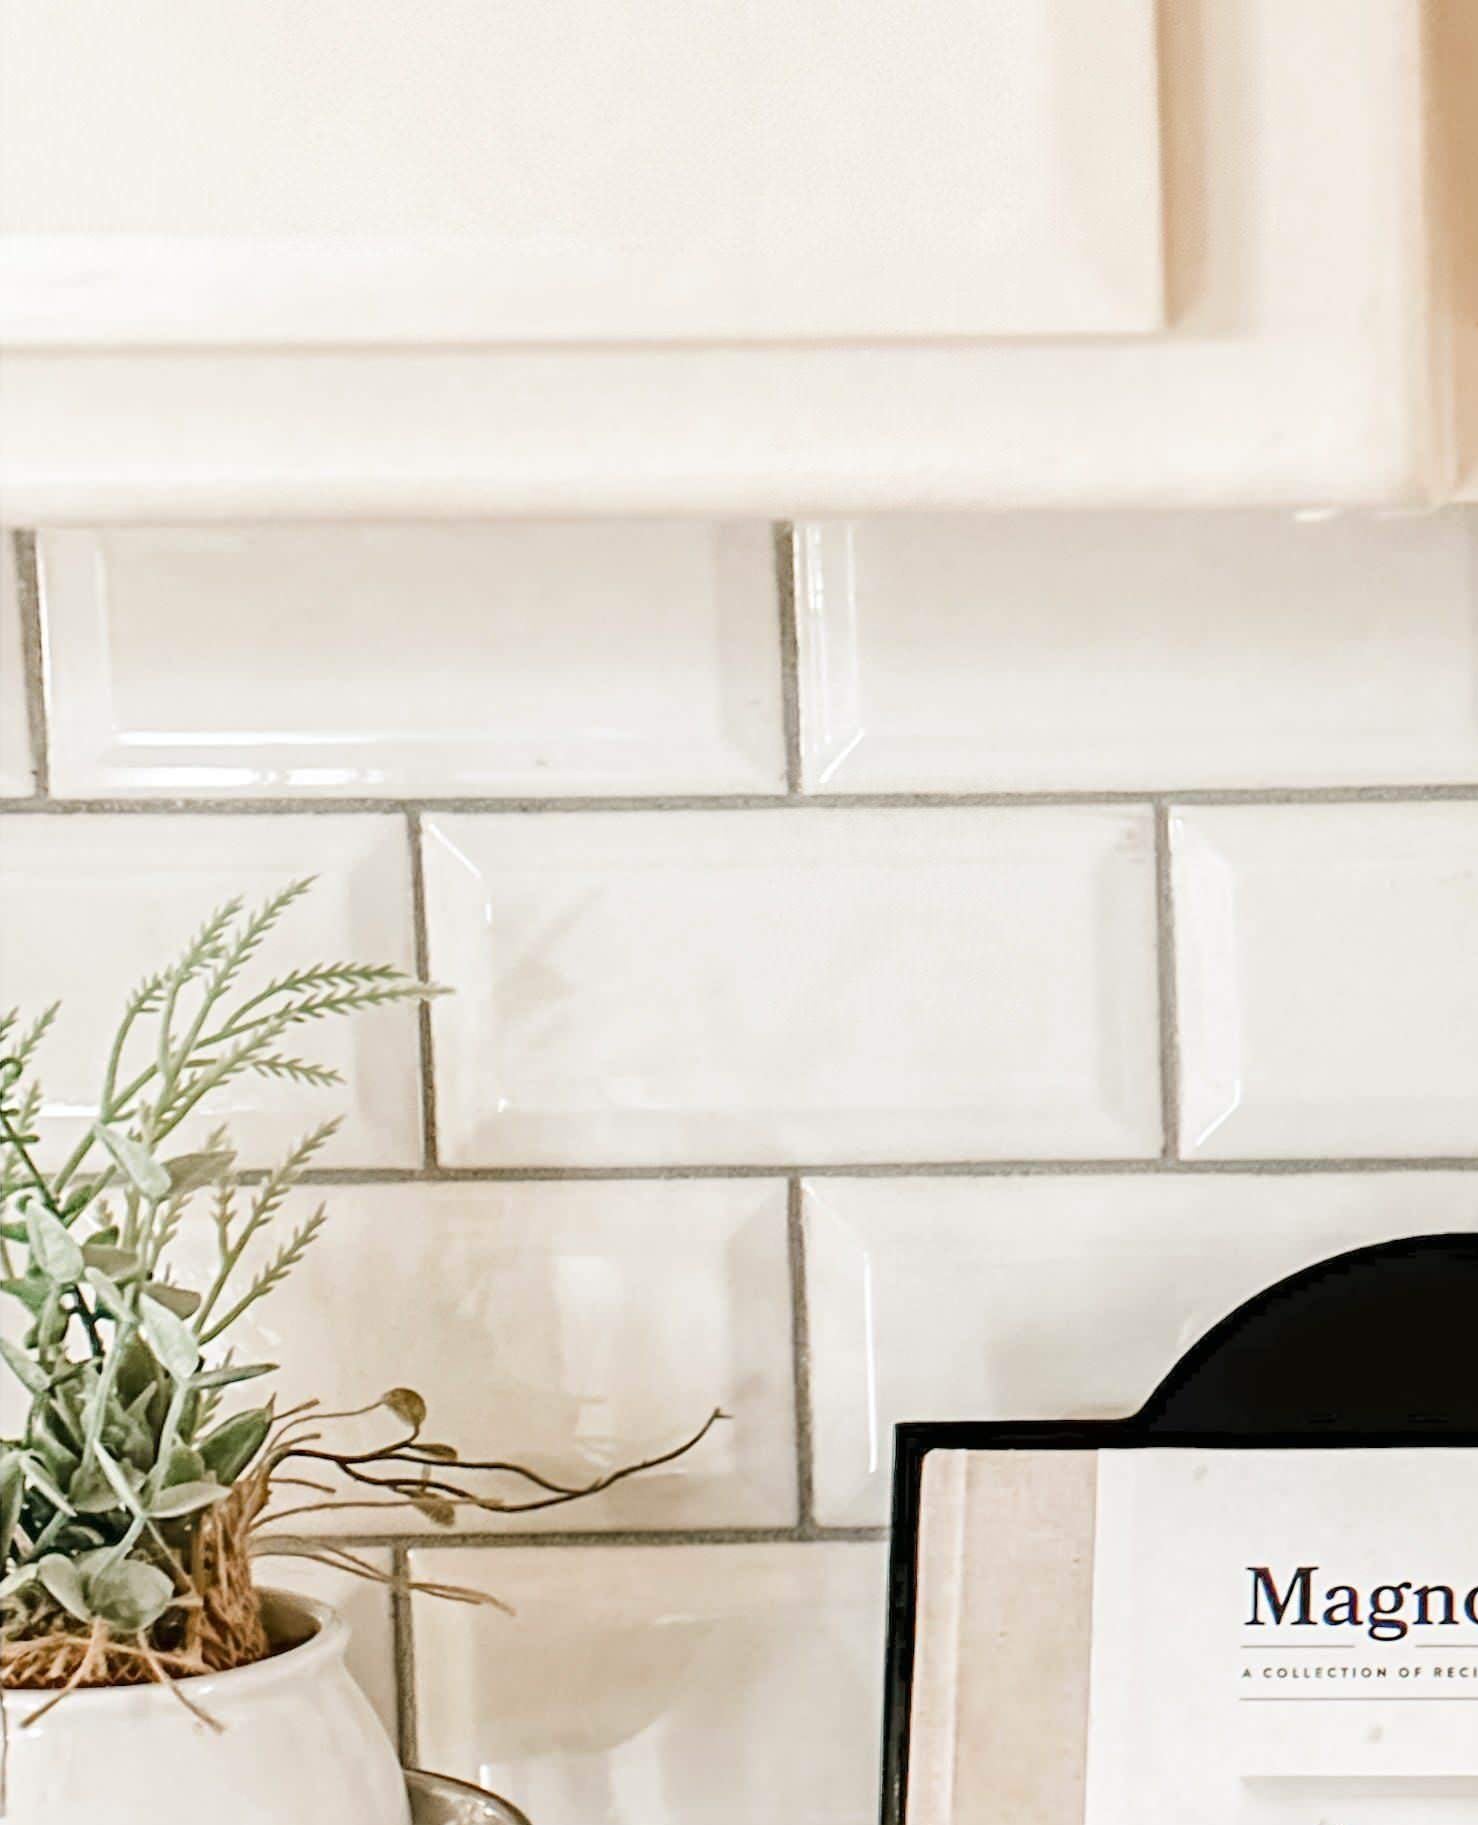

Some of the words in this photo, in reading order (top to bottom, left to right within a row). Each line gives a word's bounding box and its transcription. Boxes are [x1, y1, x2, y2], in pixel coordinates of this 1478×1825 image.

[1242, 1667, 1252, 1679] A
[1263, 1666, 1387, 1679] COLLECTION
[1398, 1666, 1424, 1679] OF
